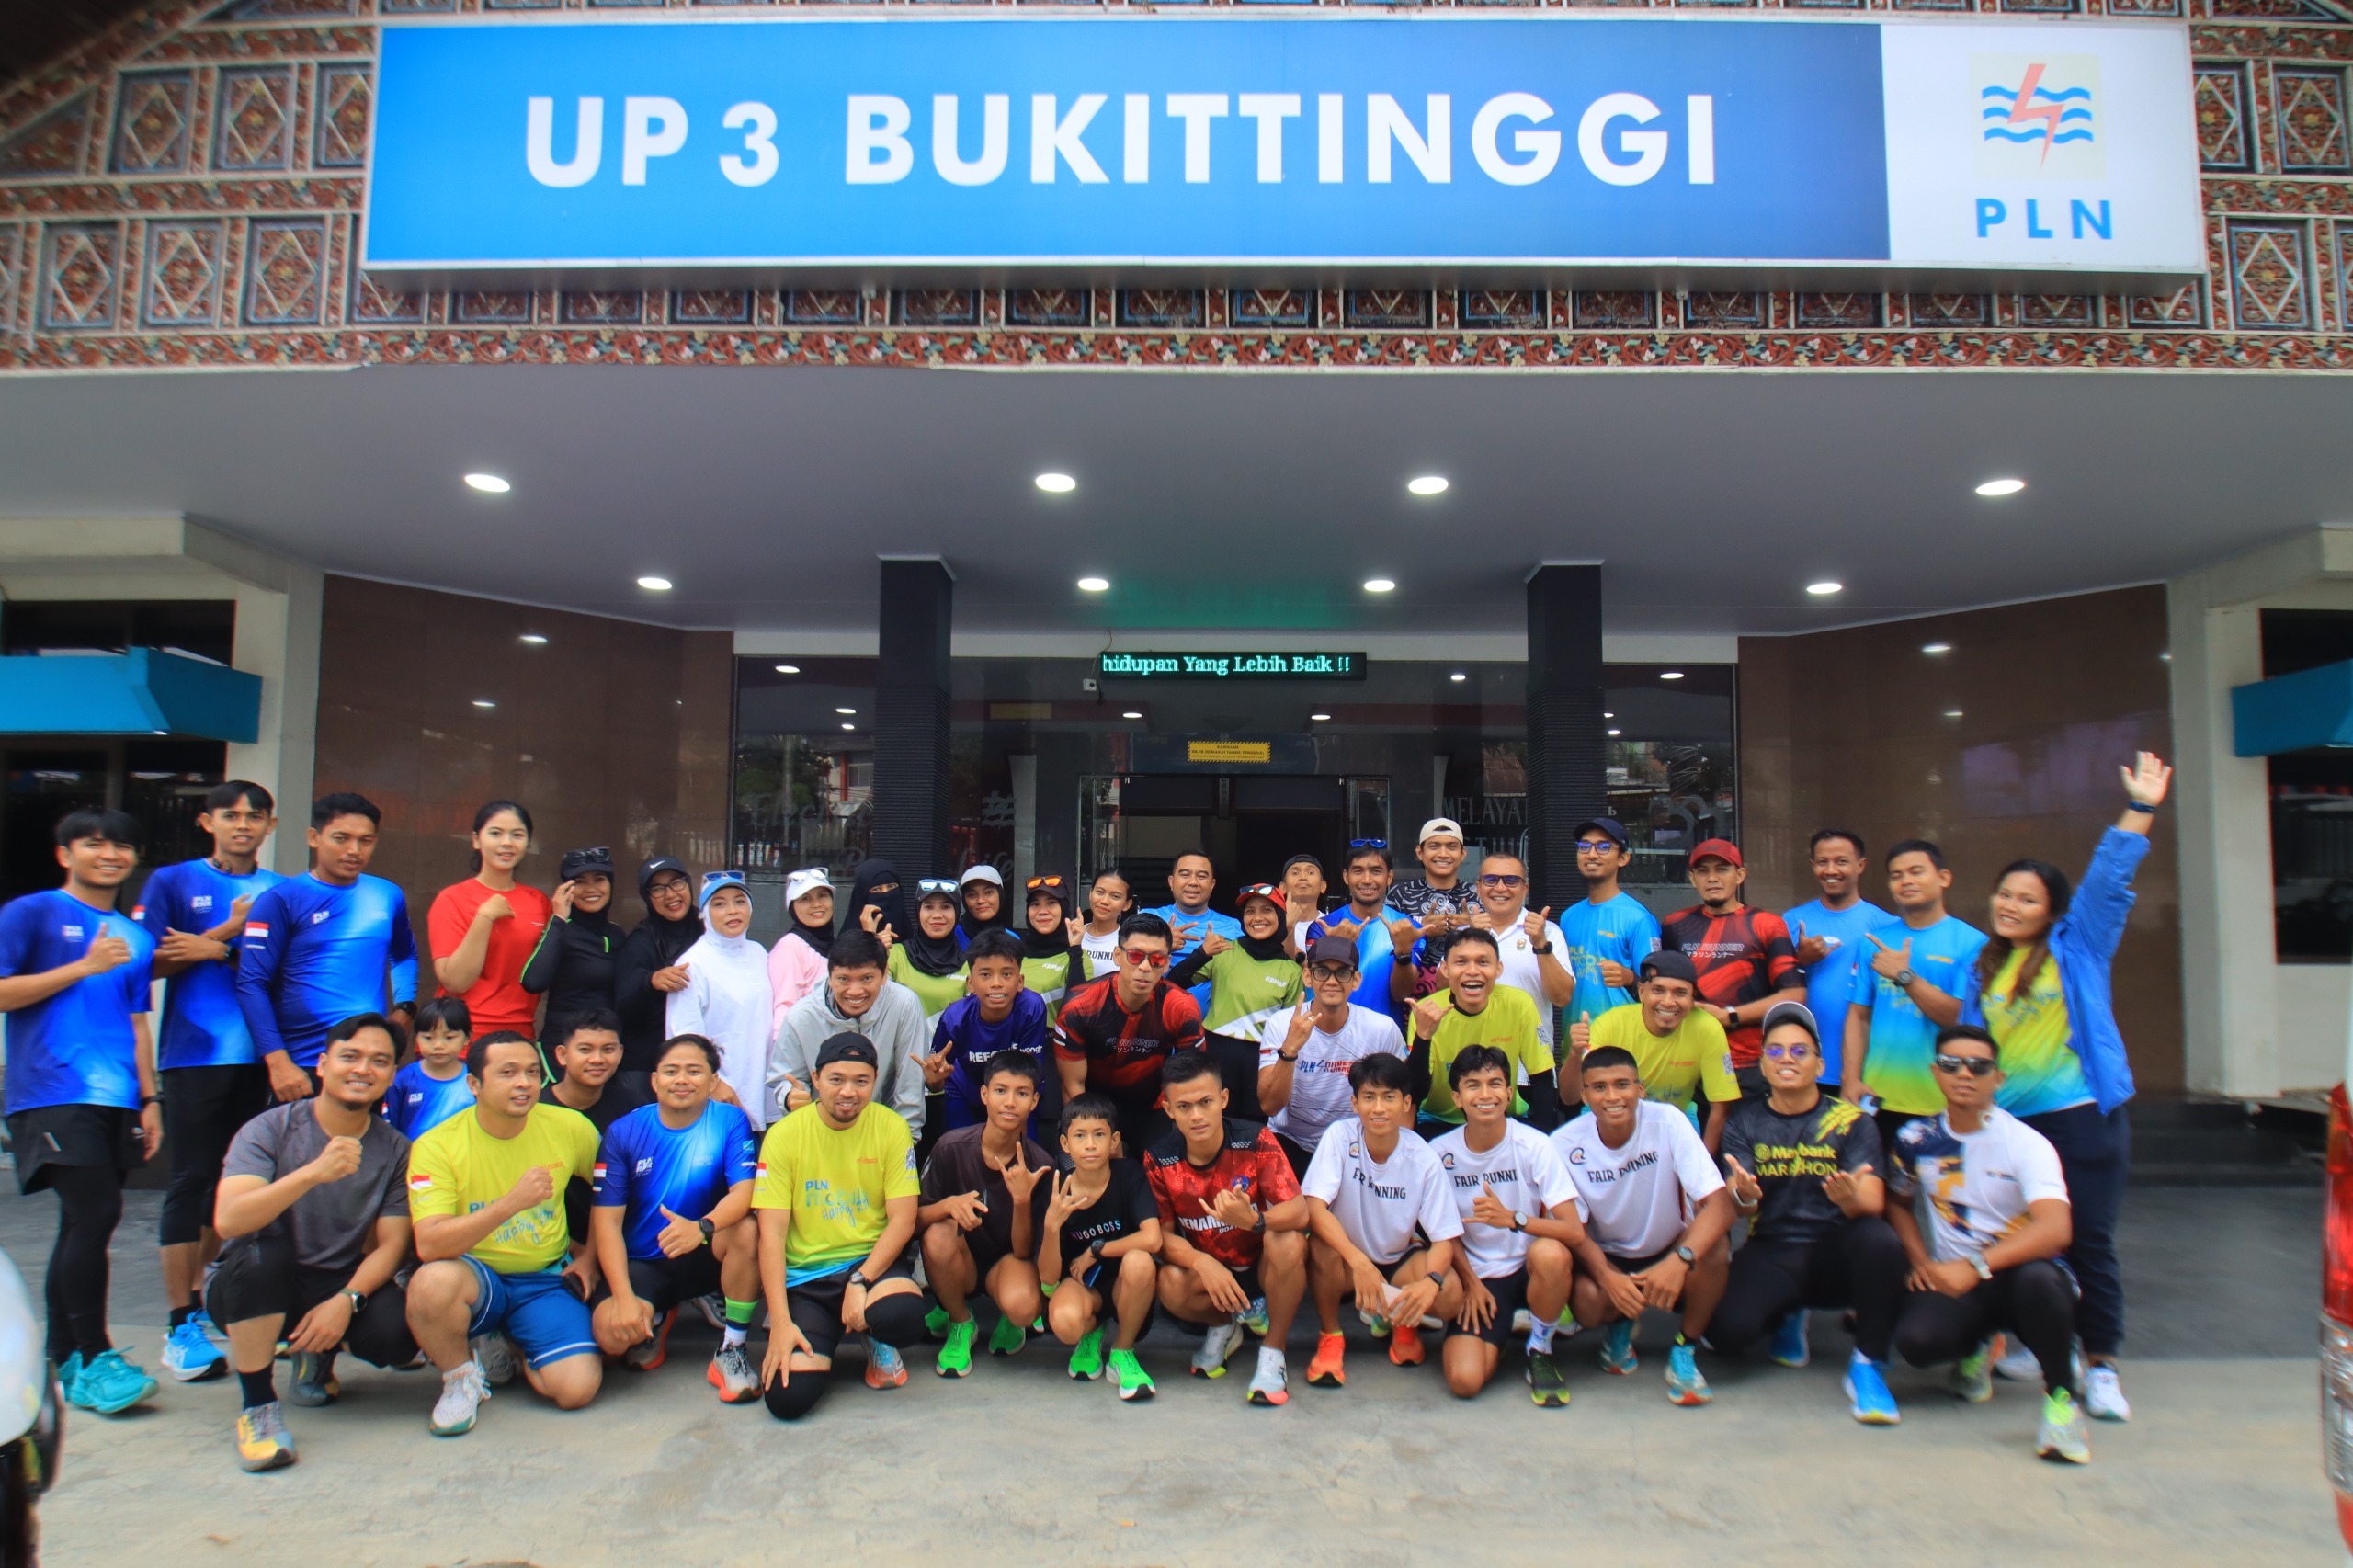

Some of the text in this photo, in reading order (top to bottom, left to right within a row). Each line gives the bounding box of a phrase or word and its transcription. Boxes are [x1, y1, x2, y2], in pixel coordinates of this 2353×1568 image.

[526, 93, 1716, 187] UP 3 BUKITTINGGI
[1975, 198, 2113, 240] PLN
[1103, 655, 1179, 676] hidupan
[1183, 656, 1229, 676] Yang
[1233, 655, 1288, 672] Lebih
[1291, 656, 1334, 672] Baik
[805, 1180, 829, 1191] PLN
[1454, 1176, 1479, 1187] FAIR
[1587, 1169, 1616, 1183] FAIR
[1071, 1220, 1121, 1239] HUGO BOSS
